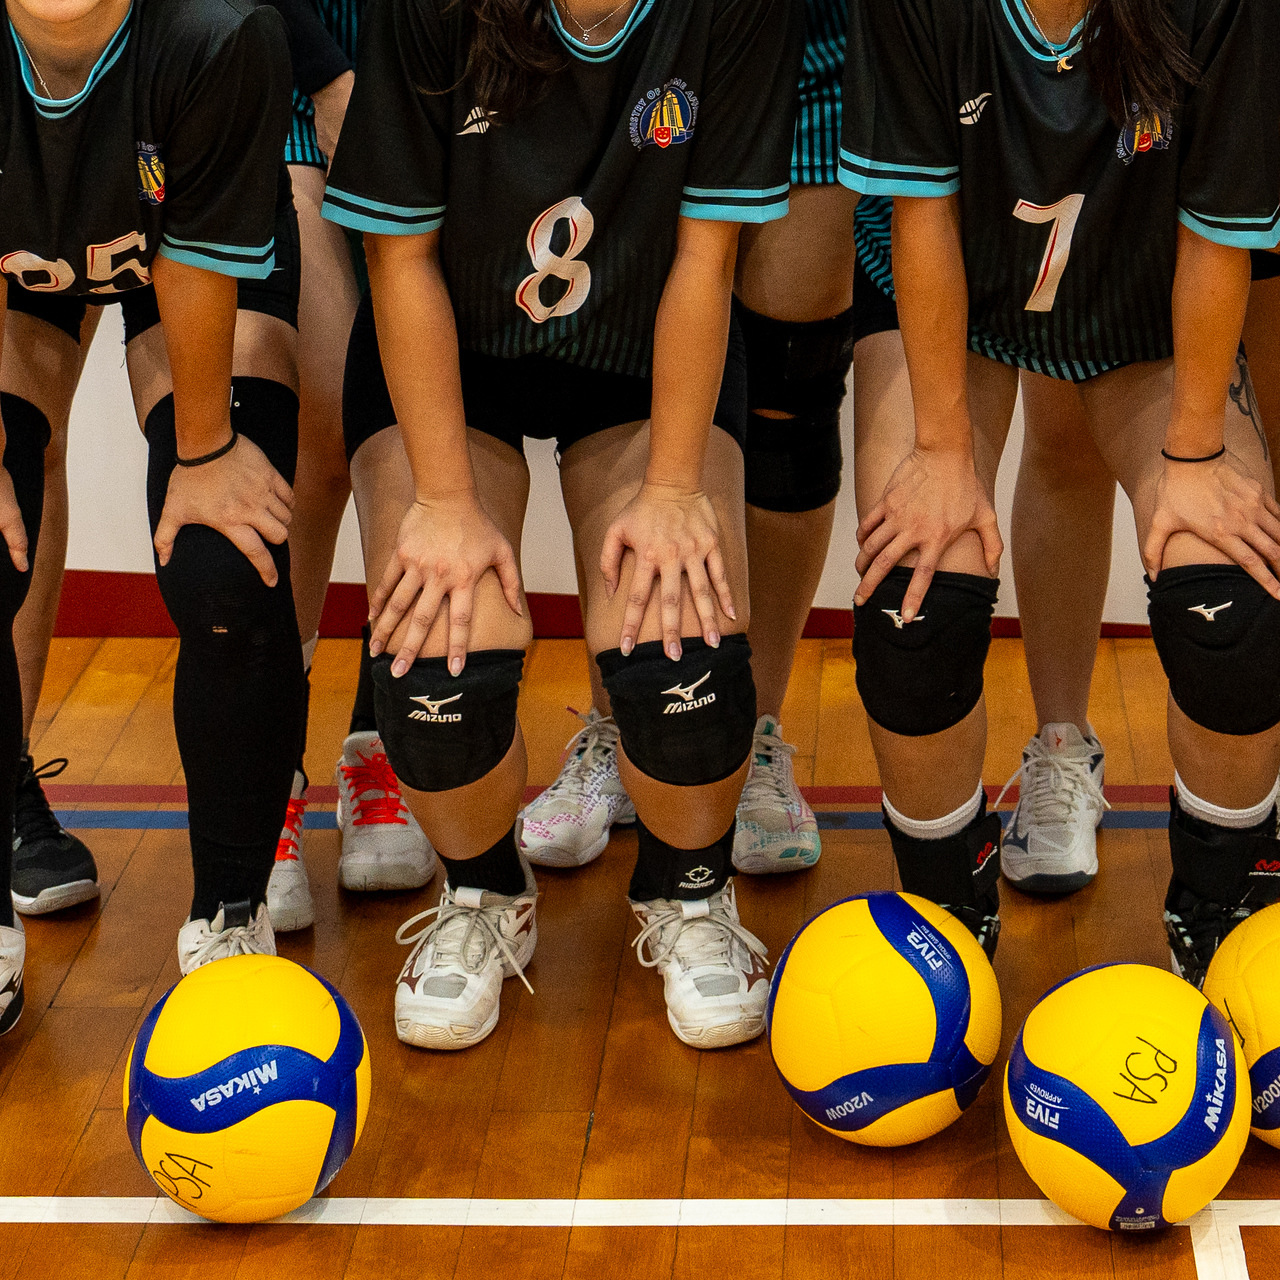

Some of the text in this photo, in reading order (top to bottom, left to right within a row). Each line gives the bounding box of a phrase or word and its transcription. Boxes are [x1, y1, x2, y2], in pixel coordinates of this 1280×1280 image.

[515, 196, 595, 323] 8
[1012, 193, 1086, 311] 7
[408, 710, 462, 722] MIZUNO
[663, 692, 716, 714] MIZUNO
[190, 1059, 279, 1112] MIKASA
[1113, 1036, 1177, 1104] PSA
[1203, 1038, 1225, 1132] MIKASA
[826, 1091, 874, 1120] V200W
